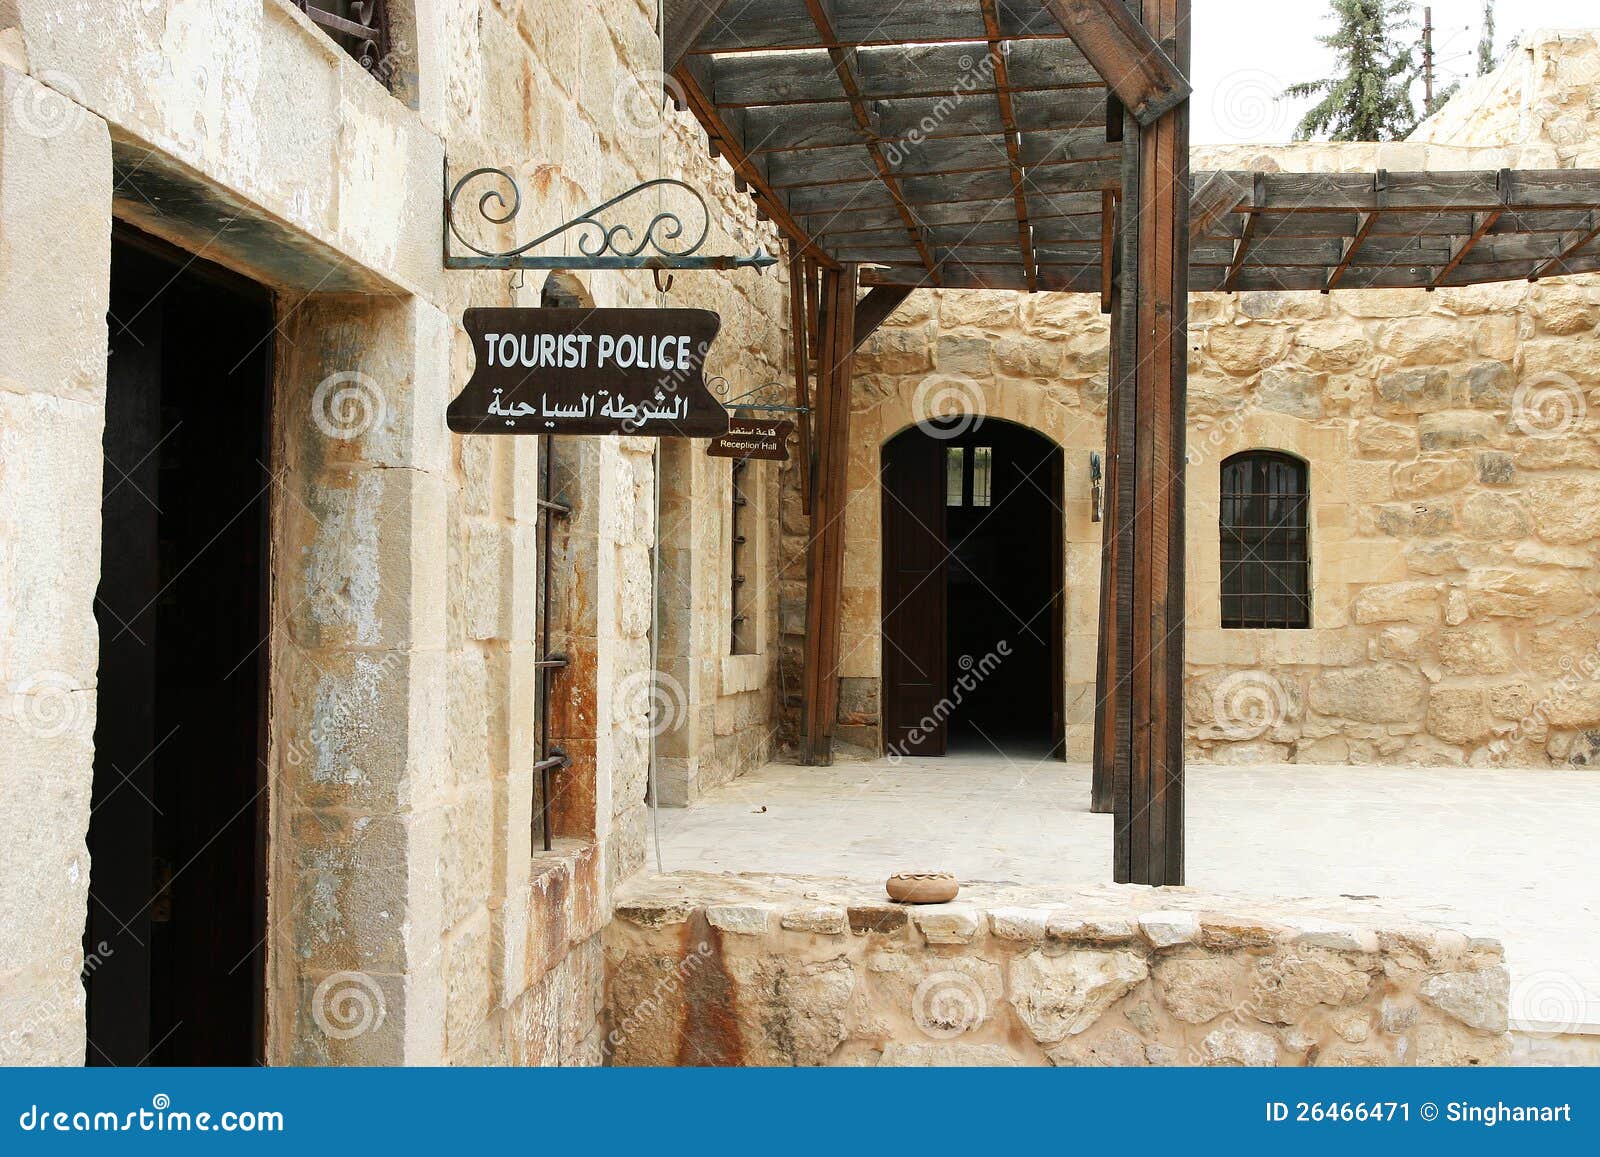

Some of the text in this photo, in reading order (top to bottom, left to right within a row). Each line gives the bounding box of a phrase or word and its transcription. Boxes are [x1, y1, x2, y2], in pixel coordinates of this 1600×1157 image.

[484, 333, 691, 370] TOURIST POLICE
[598, 389, 689, 427] الشرطة
[720, 439, 777, 450] Reception Hall
